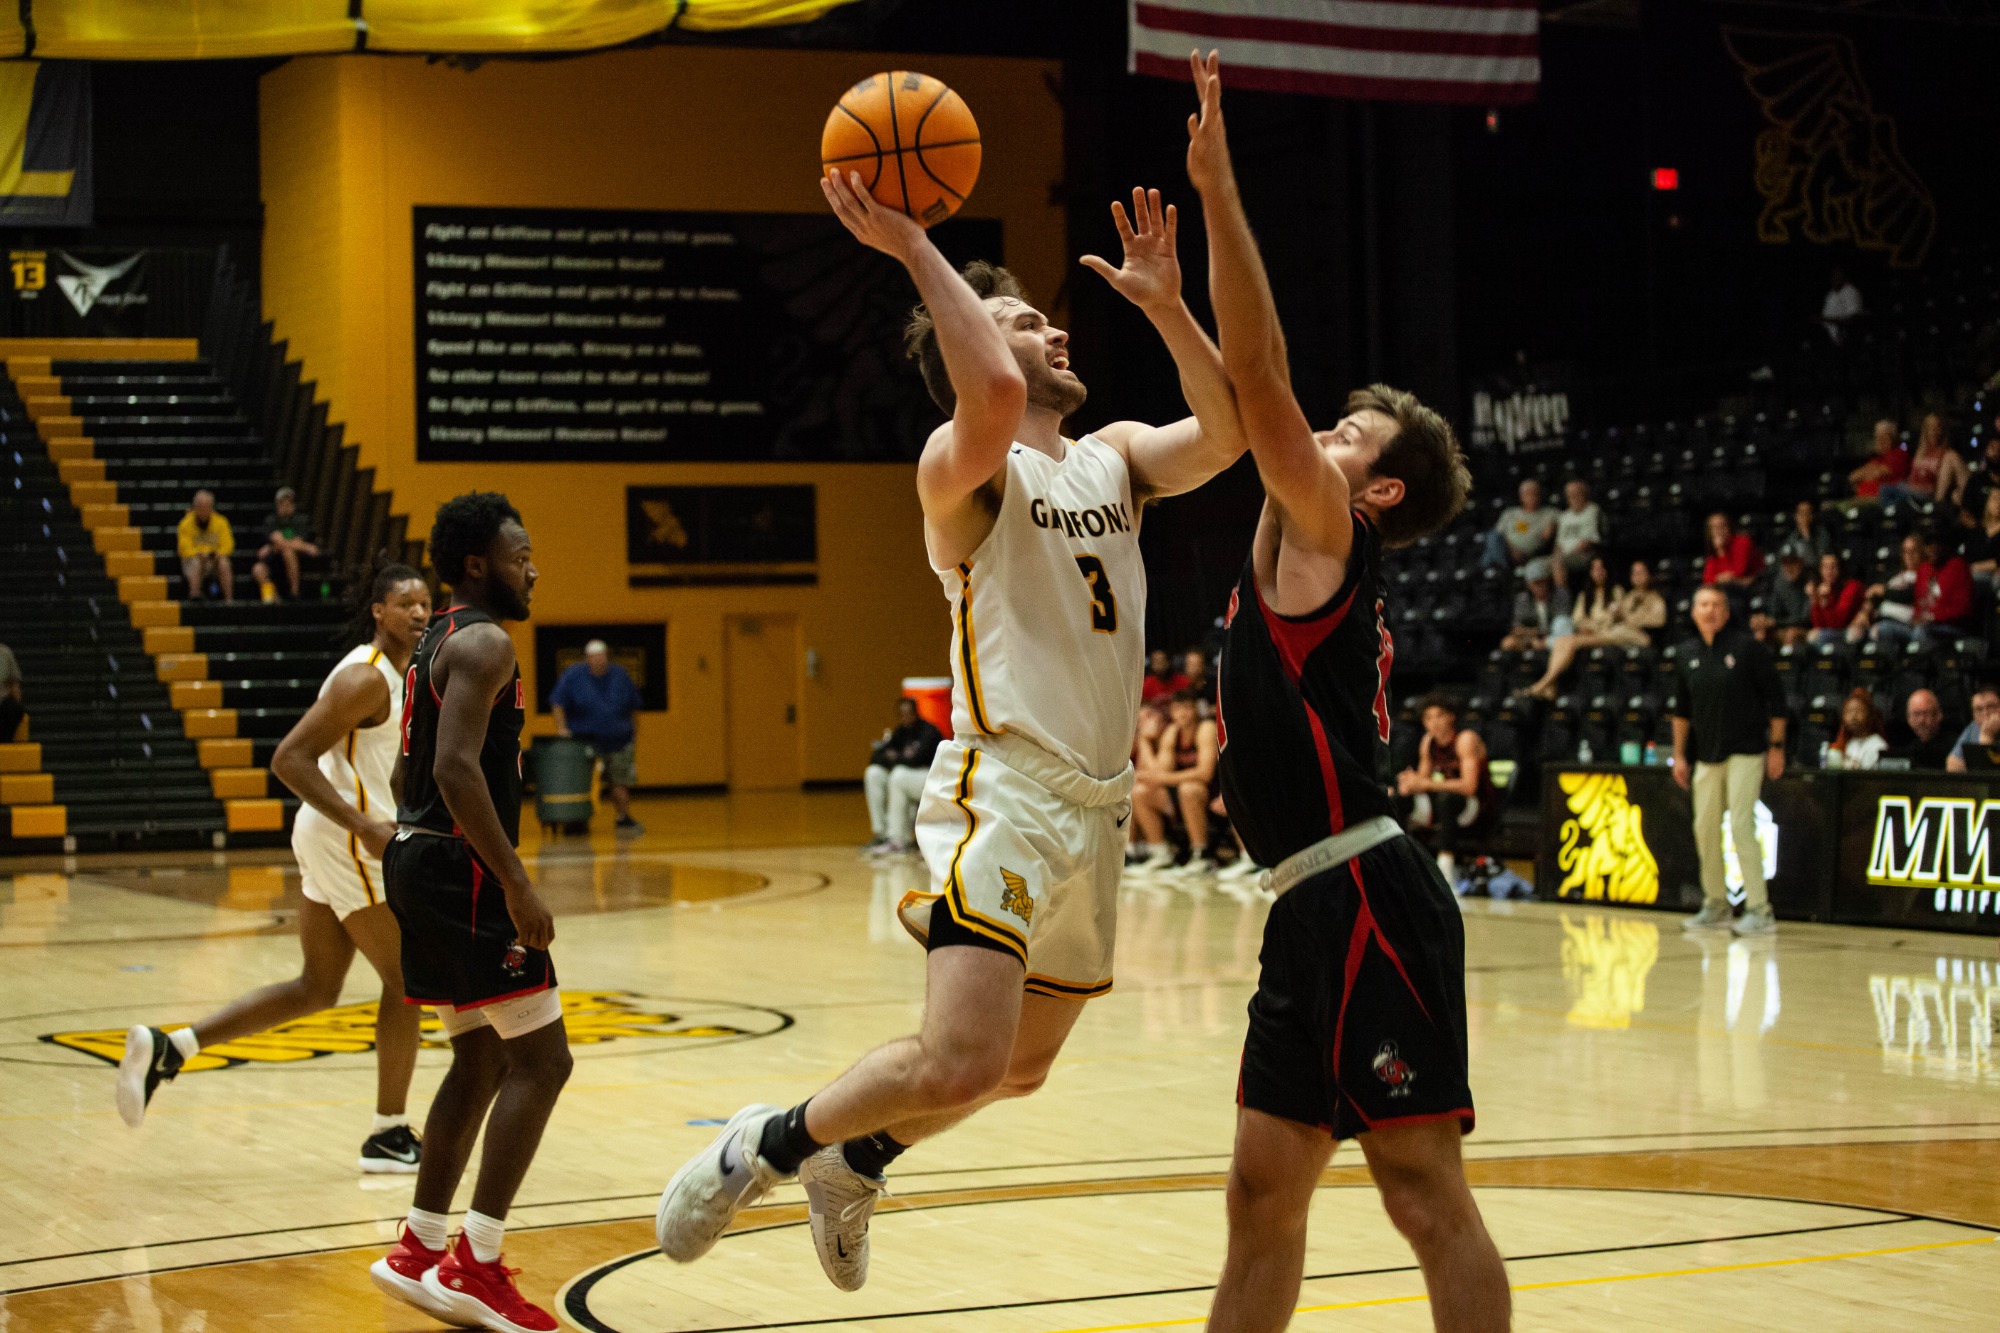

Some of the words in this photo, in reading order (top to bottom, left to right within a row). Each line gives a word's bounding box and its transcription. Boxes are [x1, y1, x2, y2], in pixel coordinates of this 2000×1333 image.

[11, 261, 46, 290] 13
[1030, 498, 1130, 538] GRIFON
[1073, 553, 1118, 635] 3
